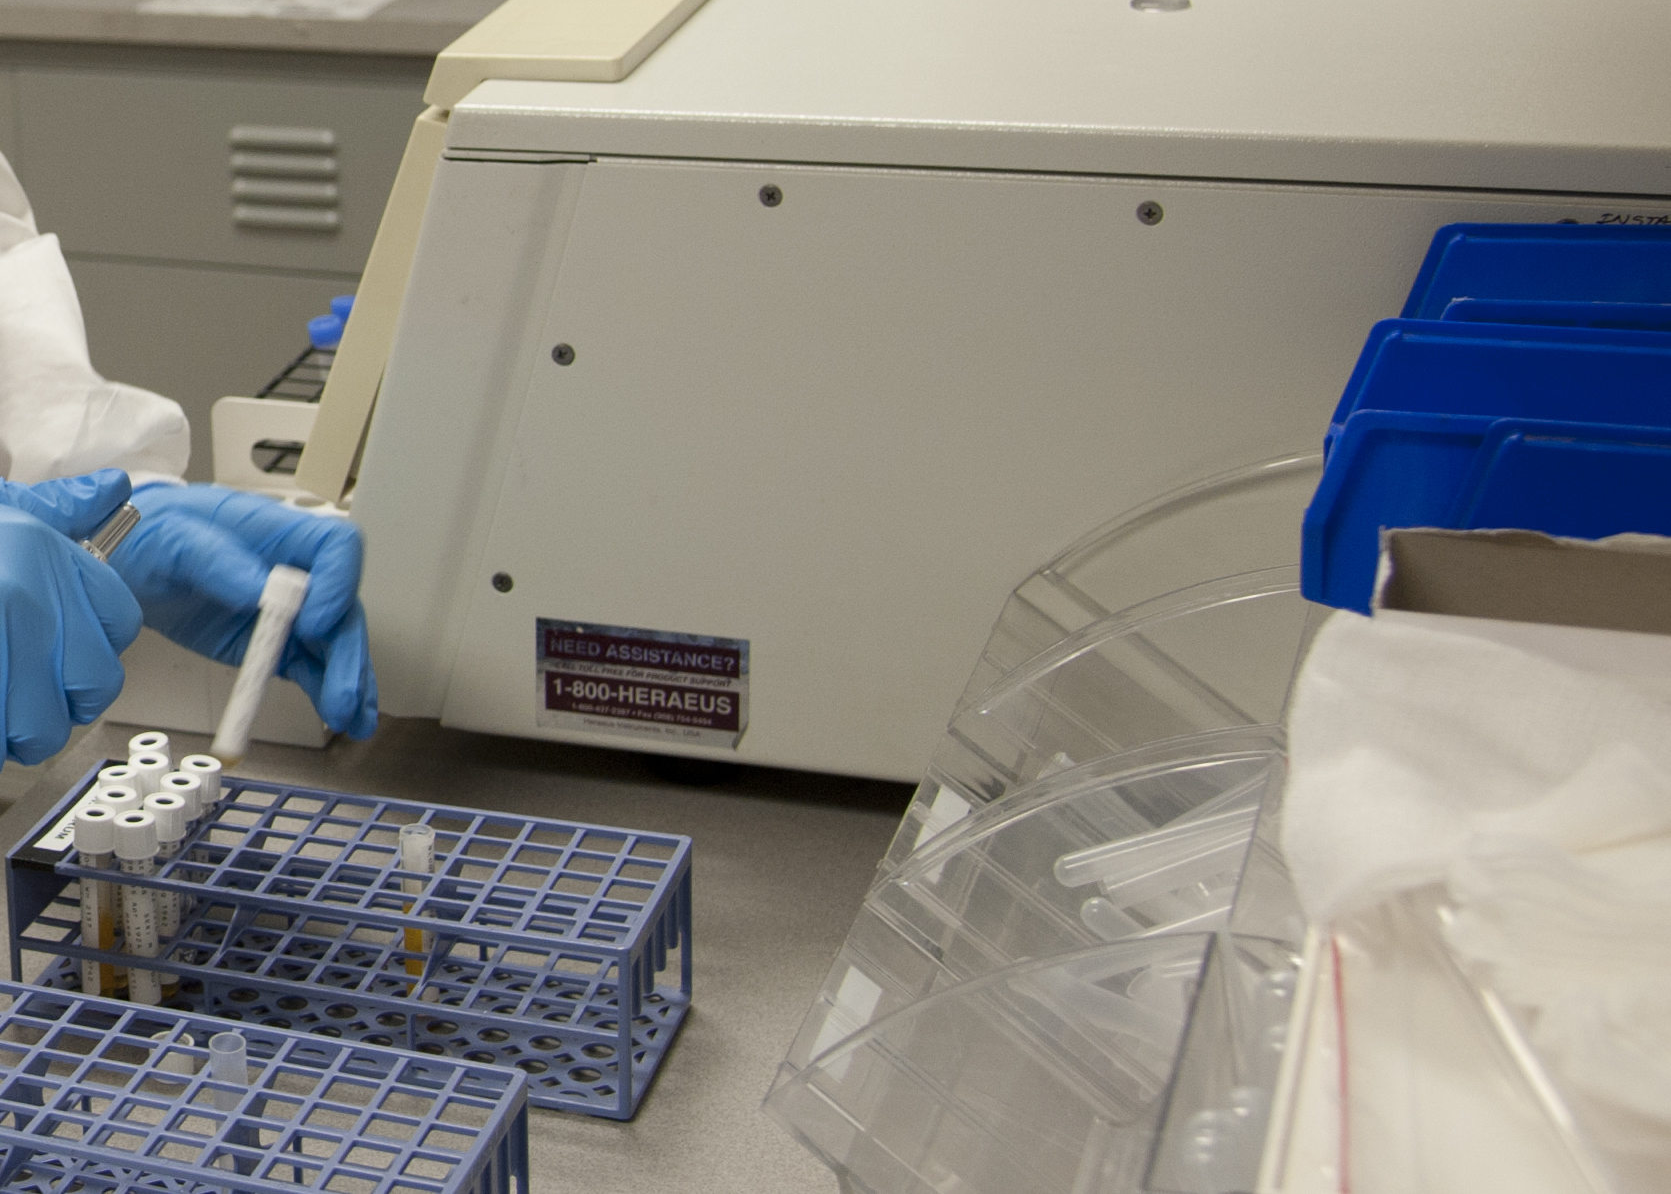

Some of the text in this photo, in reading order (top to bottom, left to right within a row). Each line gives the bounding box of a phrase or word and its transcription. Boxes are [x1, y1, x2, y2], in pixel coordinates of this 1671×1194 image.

[549, 638, 735, 672] NEED ASSISTANCE?
[552, 678, 732, 715] 1-800-HERAEUS
[645, 671, 688, 684] PRODUCT
[690, 677, 732, 688] SUPPORT
